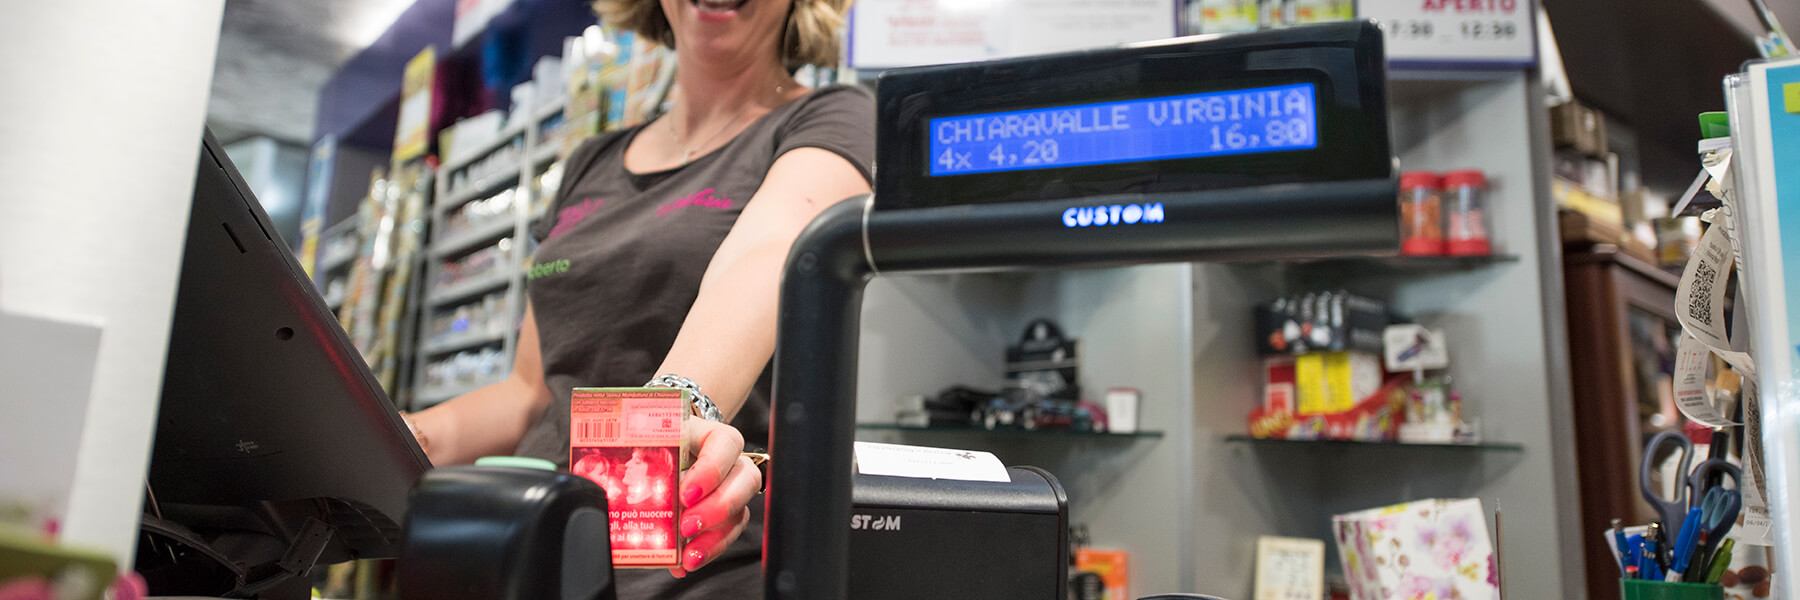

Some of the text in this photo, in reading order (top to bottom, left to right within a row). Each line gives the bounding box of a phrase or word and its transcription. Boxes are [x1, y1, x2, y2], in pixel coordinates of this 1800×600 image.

[938, 89, 1307, 145] CHIARAVALLE VIRGINIA
[938, 117, 1308, 170] 4x 4,20 16,80
[1062, 202, 1164, 228] CUSTOM
[528, 259, 570, 280] oberto
[621, 509, 638, 520] può
[639, 510, 673, 518] nuocere
[851, 514, 900, 531] STOM
[623, 521, 638, 530] alla
[640, 521, 654, 530] tua
[617, 532, 625, 542] ai
[627, 532, 643, 542] tui
